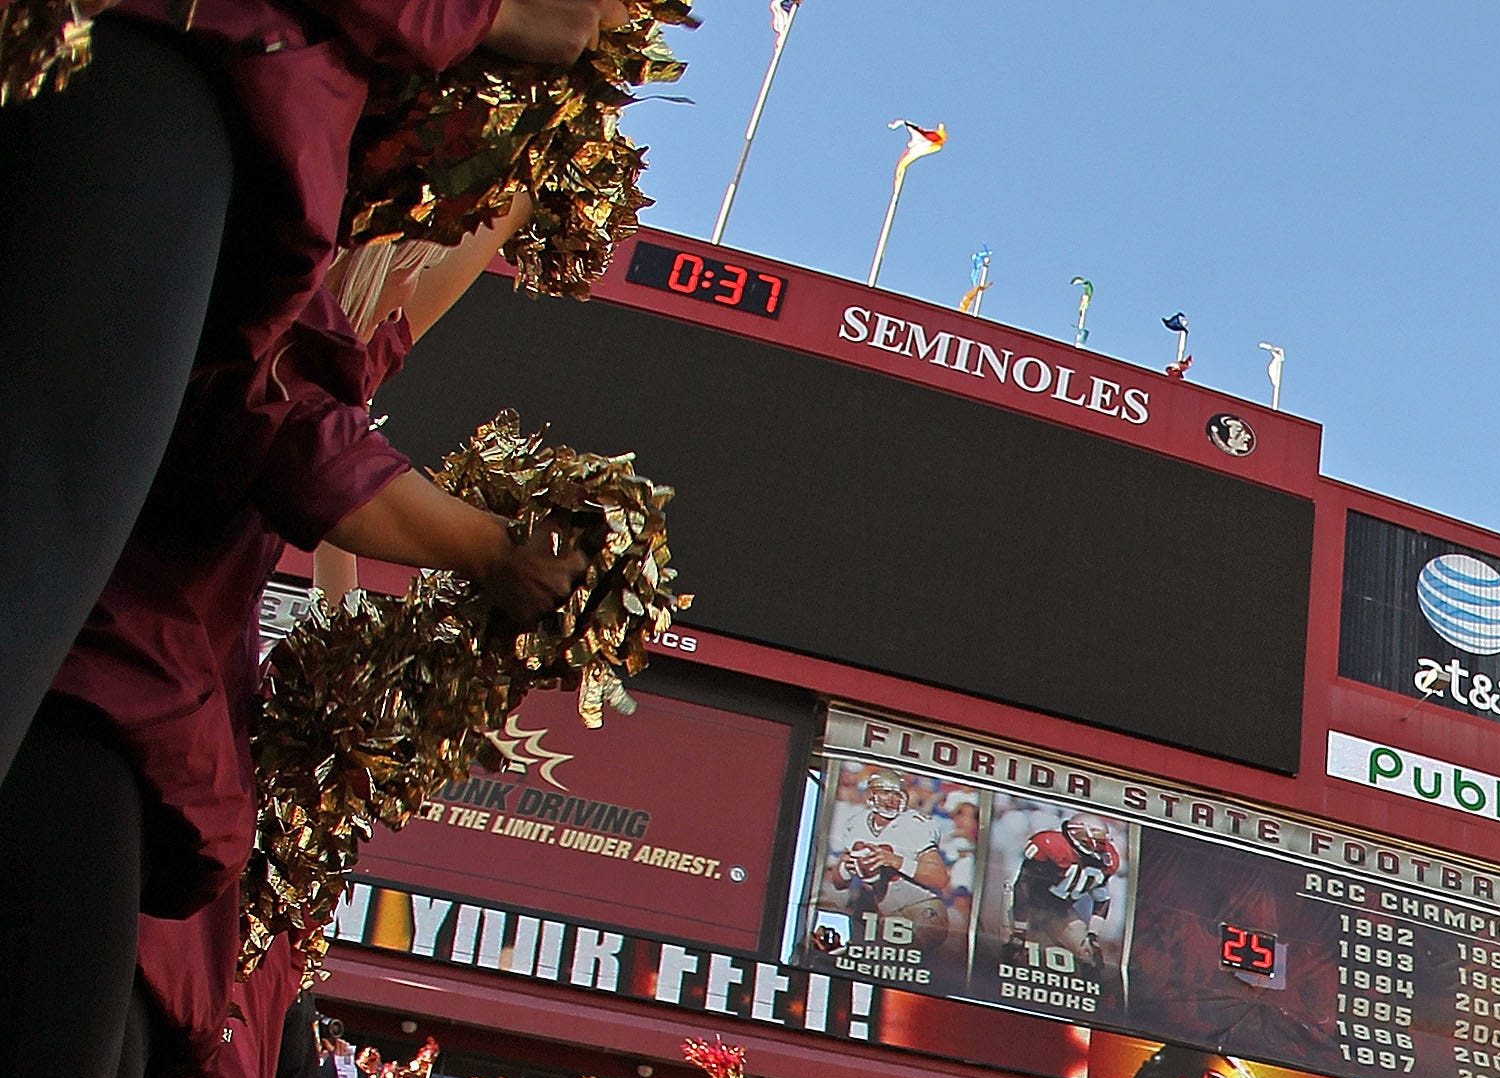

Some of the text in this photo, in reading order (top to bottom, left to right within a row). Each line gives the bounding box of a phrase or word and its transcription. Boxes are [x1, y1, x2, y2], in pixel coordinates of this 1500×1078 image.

[667, 252, 784, 314] 0:37
[838, 305, 1151, 426] SEMINOLES
[863, 723, 1092, 799] FLORIDA
[1123, 786, 1282, 845] STATE
[515, 786, 652, 840] DRIVING
[447, 805, 492, 831] THE
[491, 814, 556, 846] LIMIT.
[558, 828, 634, 860] UNDER
[631, 844, 723, 880] ARREST.
[1304, 872, 1367, 903] ACC
[860, 911, 915, 945] 16
[1339, 913, 1416, 948] 1992
[845, 943, 923, 965] CHRIS
[1023, 941, 1076, 974] 10
[1221, 925, 1275, 970] 25
[1338, 939, 1416, 973] 1993
[1001, 981, 1097, 1013] BROOKS
[1337, 965, 1417, 1000] 1994
[1336, 993, 1414, 1028] 1995
[1335, 1019, 1415, 1050] 1996
[1338, 1043, 1417, 1074] 1997
